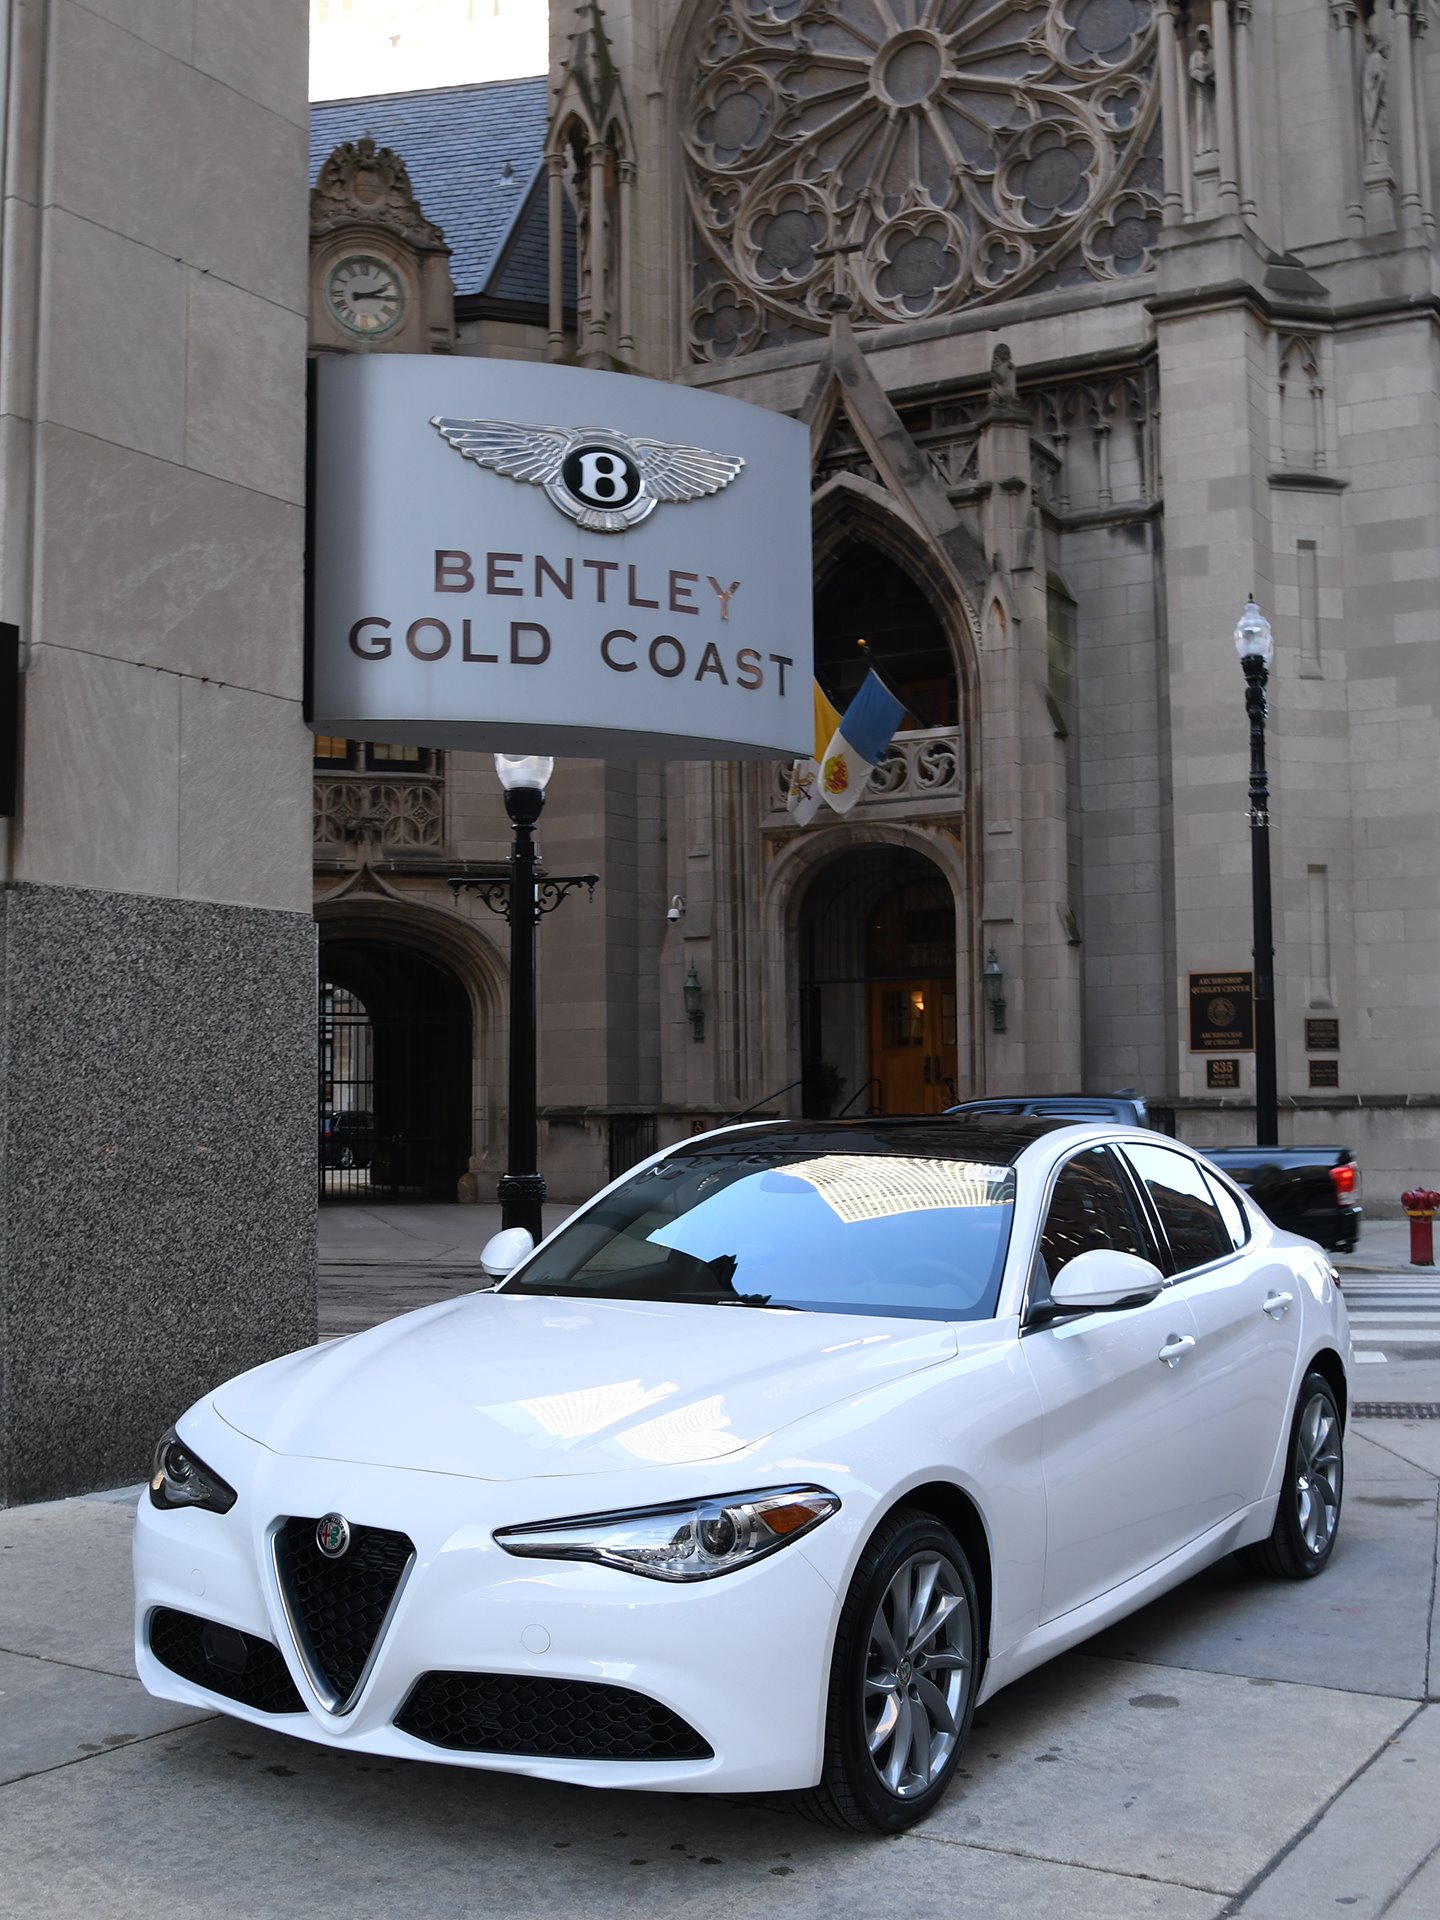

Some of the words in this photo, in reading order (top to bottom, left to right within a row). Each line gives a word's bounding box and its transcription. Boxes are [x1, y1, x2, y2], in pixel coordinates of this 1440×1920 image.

[578, 451, 629, 502] B
[434, 549, 741, 620] BENTLEY
[348, 616, 551, 666] GOLD
[600, 629, 793, 697] COAST
[1212, 1061, 1233, 1073] 835
